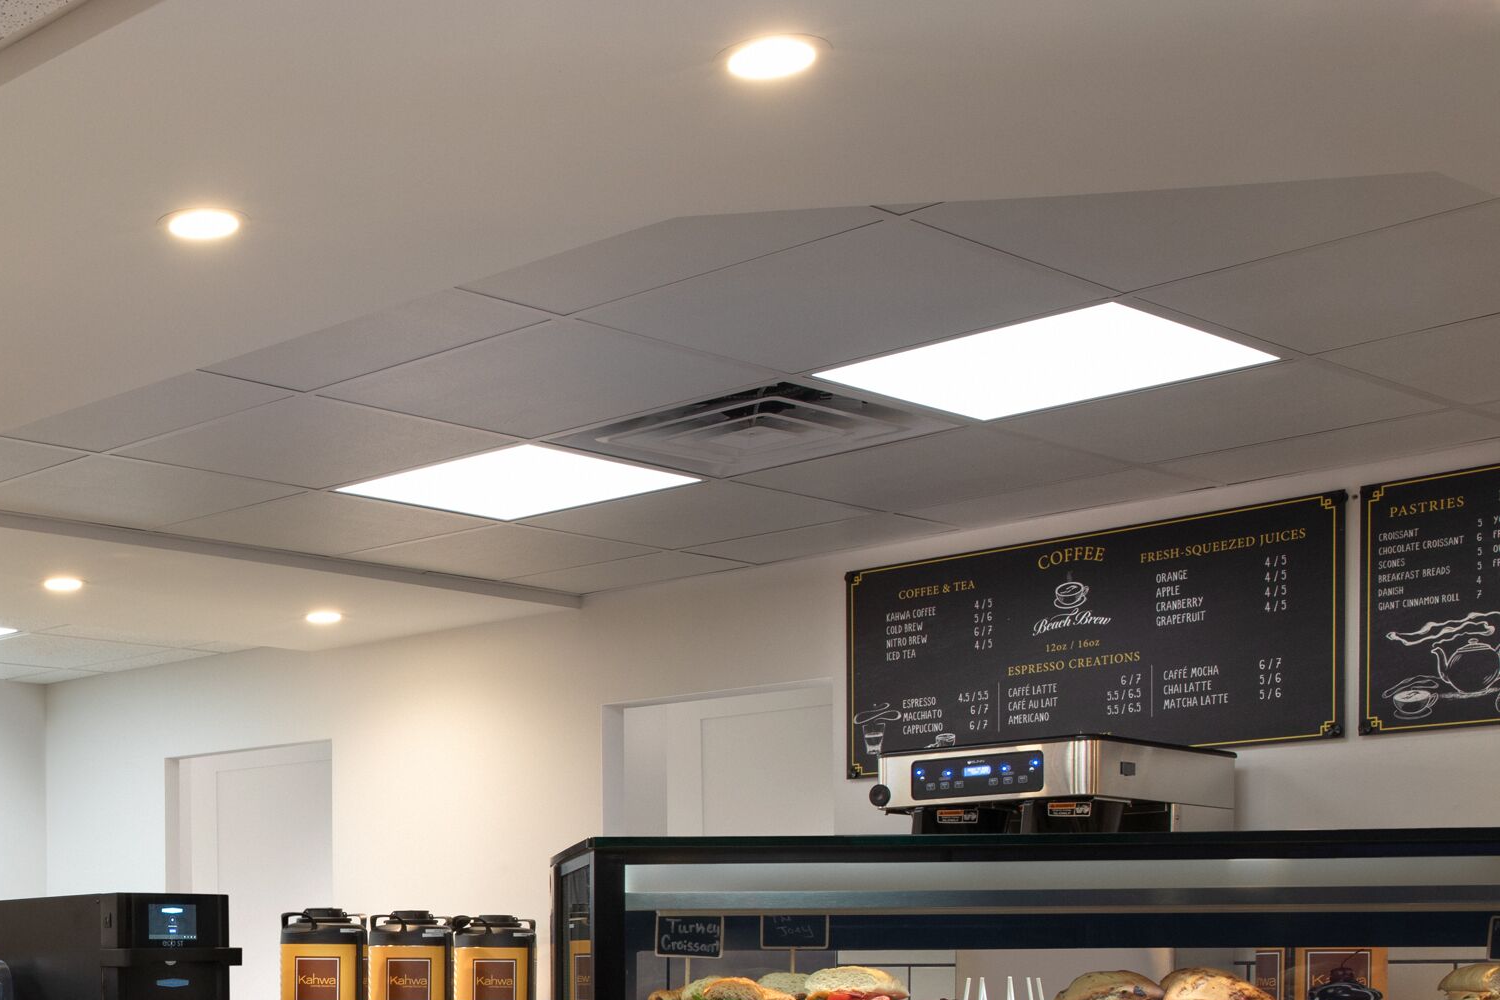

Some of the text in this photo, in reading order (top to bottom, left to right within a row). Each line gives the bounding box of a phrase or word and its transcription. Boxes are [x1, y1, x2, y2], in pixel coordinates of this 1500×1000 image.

[1389, 495, 1465, 518] PASTRIES
[1477, 518, 1483, 527] 5
[1378, 527, 1420, 542] CROISSANT
[1476, 532, 1483, 542] 6
[1140, 527, 1307, 564] FRESH-SQUEEZED JUICES
[1378, 535, 1465, 556] CHOCOLATE CROISSANT
[1477, 546, 1483, 556] 5
[1037, 546, 1106, 570] COFFEE
[1378, 558, 1406, 570] SCONES
[1477, 561, 1483, 571] 5
[1155, 569, 1188, 584] ORANGE
[1378, 565, 1451, 583] BREAKFAST BREADS
[1476, 575, 1482, 585] 4
[898, 580, 976, 600] COFFEE & TEA
[1155, 585, 1180, 599] APPLE
[1378, 586, 1404, 597] DANISH
[1476, 589, 1482, 599] 7
[1155, 596, 1204, 613] CRANBERRY
[1378, 593, 1460, 611] GIANT CINNAMON ROLL
[886, 606, 937, 622] KAHWA COFFEE
[1155, 610, 1207, 627] GRAPEFRUIT
[886, 621, 923, 635] COLD BREW
[1033, 610, 1112, 637] Beach Brew
[886, 634, 928, 649] NITRO BREW
[1045, 643, 1067, 653] 12oz
[1078, 639, 1101, 649] 16oz
[886, 649, 916, 661] ICED TEA
[1008, 651, 1141, 676] ESPRESSO CREATIONS
[1163, 664, 1220, 681] CAFFÉ MOCHA
[1008, 683, 1058, 698] CAFFÉ LATTE
[1163, 680, 1212, 695] CHAI LATTE
[902, 696, 936, 709] ESPRESSO
[1008, 697, 1058, 712] CAFÉ AU LAIT
[1163, 693, 1229, 710] MATCHA LATTE
[902, 709, 942, 722] MACCHIATO
[1008, 713, 1050, 725] AMERICANO
[902, 723, 944, 735] CAPPUCCINO
[298, 972, 337, 985] Kahwa
[389, 973, 427, 986] Kahwa
[476, 973, 513, 986] Kahwa
